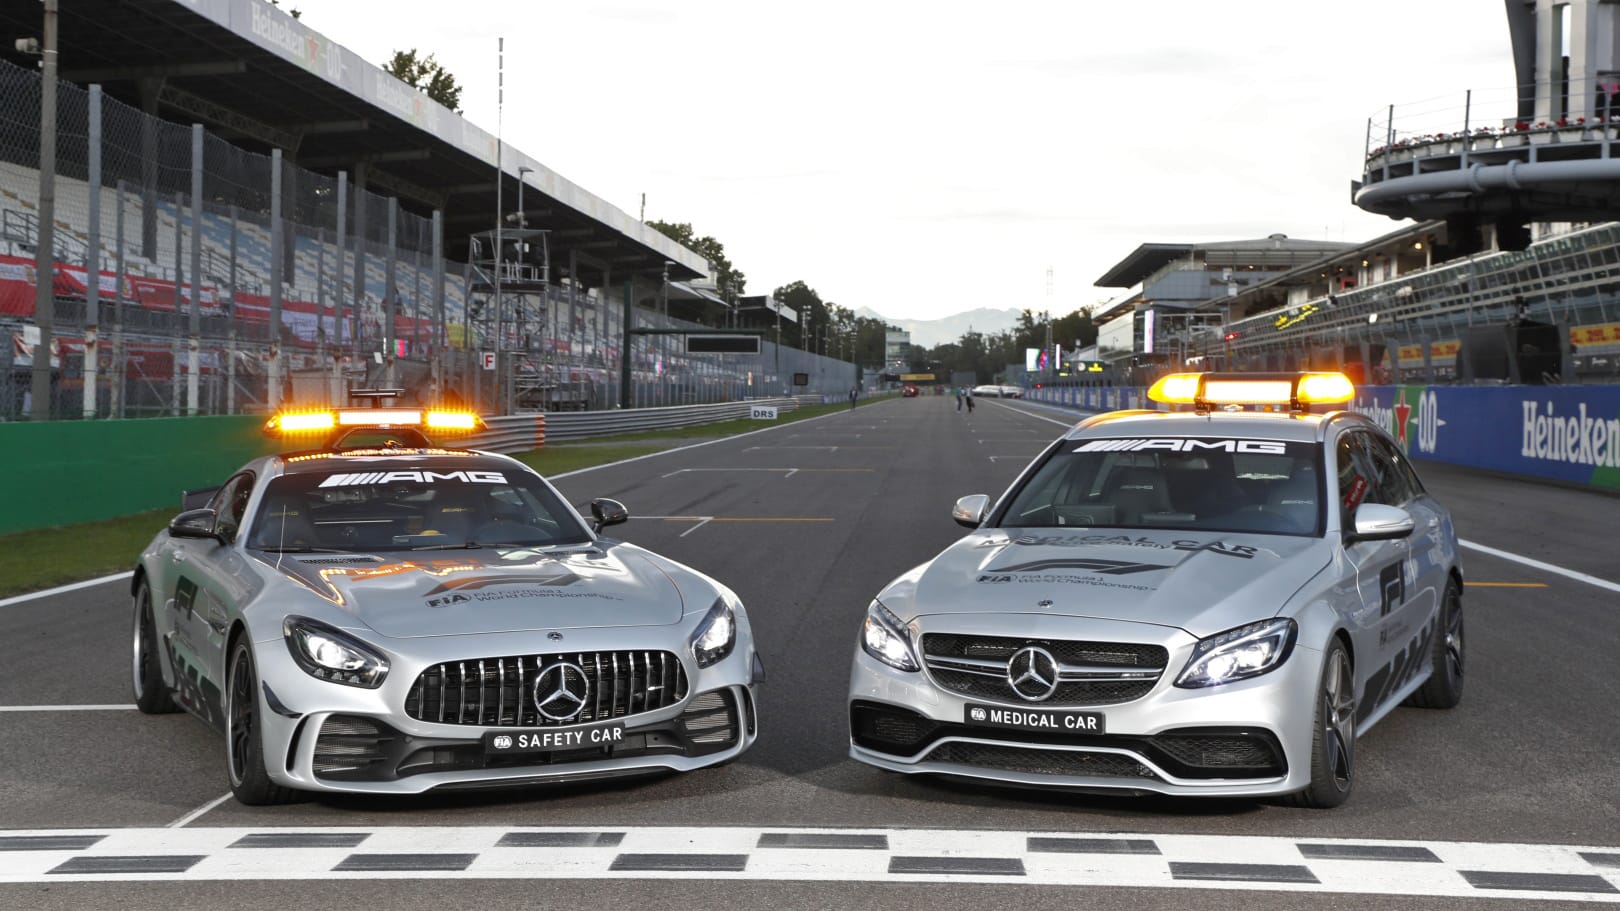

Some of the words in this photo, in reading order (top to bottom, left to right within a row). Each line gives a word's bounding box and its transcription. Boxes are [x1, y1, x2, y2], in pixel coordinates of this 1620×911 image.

[485, 355, 494, 368] F
[753, 410, 774, 418] DRS
[1521, 400, 1620, 468] Heineken
[1132, 440, 1286, 454] AMG
[378, 471, 508, 484] AMG
[1172, 540, 1258, 556] CAR
[1057, 579, 1148, 590] Championship
[428, 593, 468, 606] FIA
[971, 708, 986, 720] FIA
[990, 710, 1058, 728] MEDICAL
[1064, 715, 1097, 729] CAR
[494, 736, 512, 748] FIA
[518, 731, 583, 748] SAFETY
[591, 727, 622, 743] CAR
